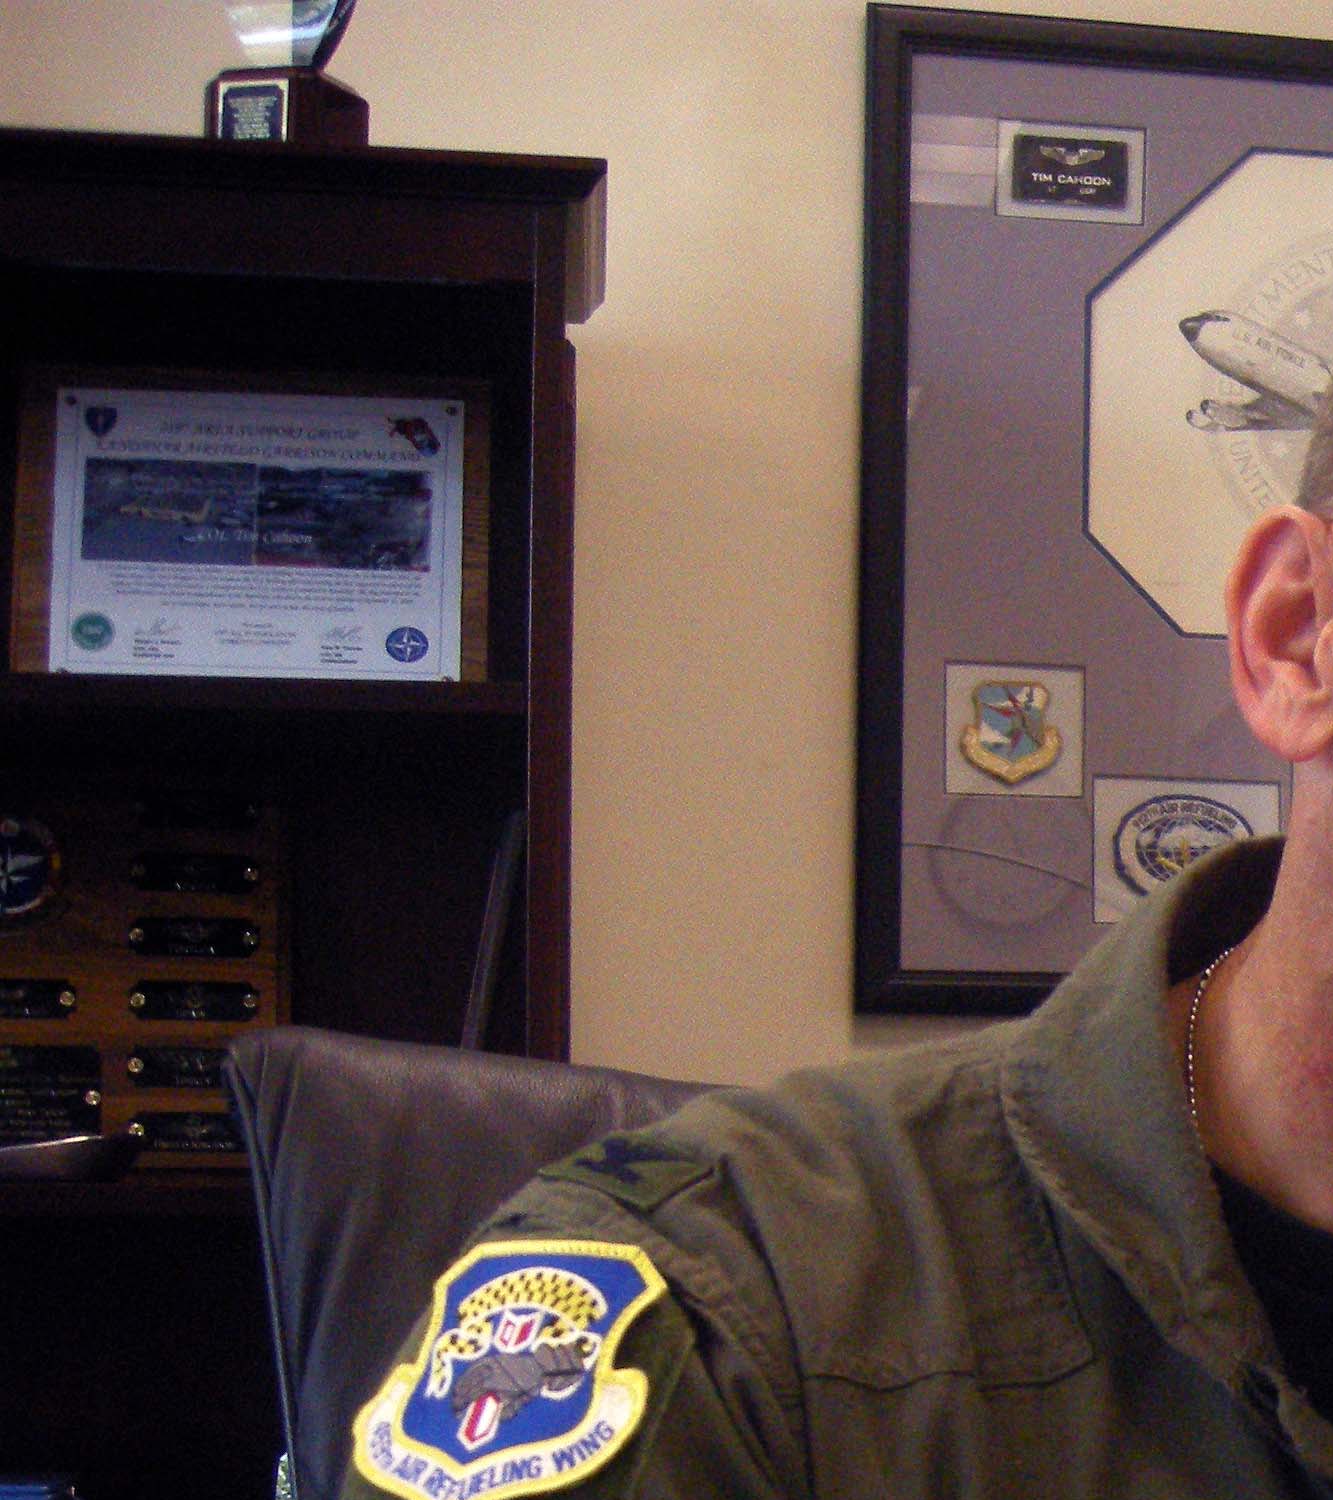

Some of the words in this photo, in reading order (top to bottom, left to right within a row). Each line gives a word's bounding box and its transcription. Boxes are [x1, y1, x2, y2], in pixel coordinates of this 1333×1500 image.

[1031, 172, 1052, 182] TIM
[1057, 174, 1111, 186] CAHOON
[393, 1455, 428, 1484] AIR
[552, 1419, 617, 1473] WING
